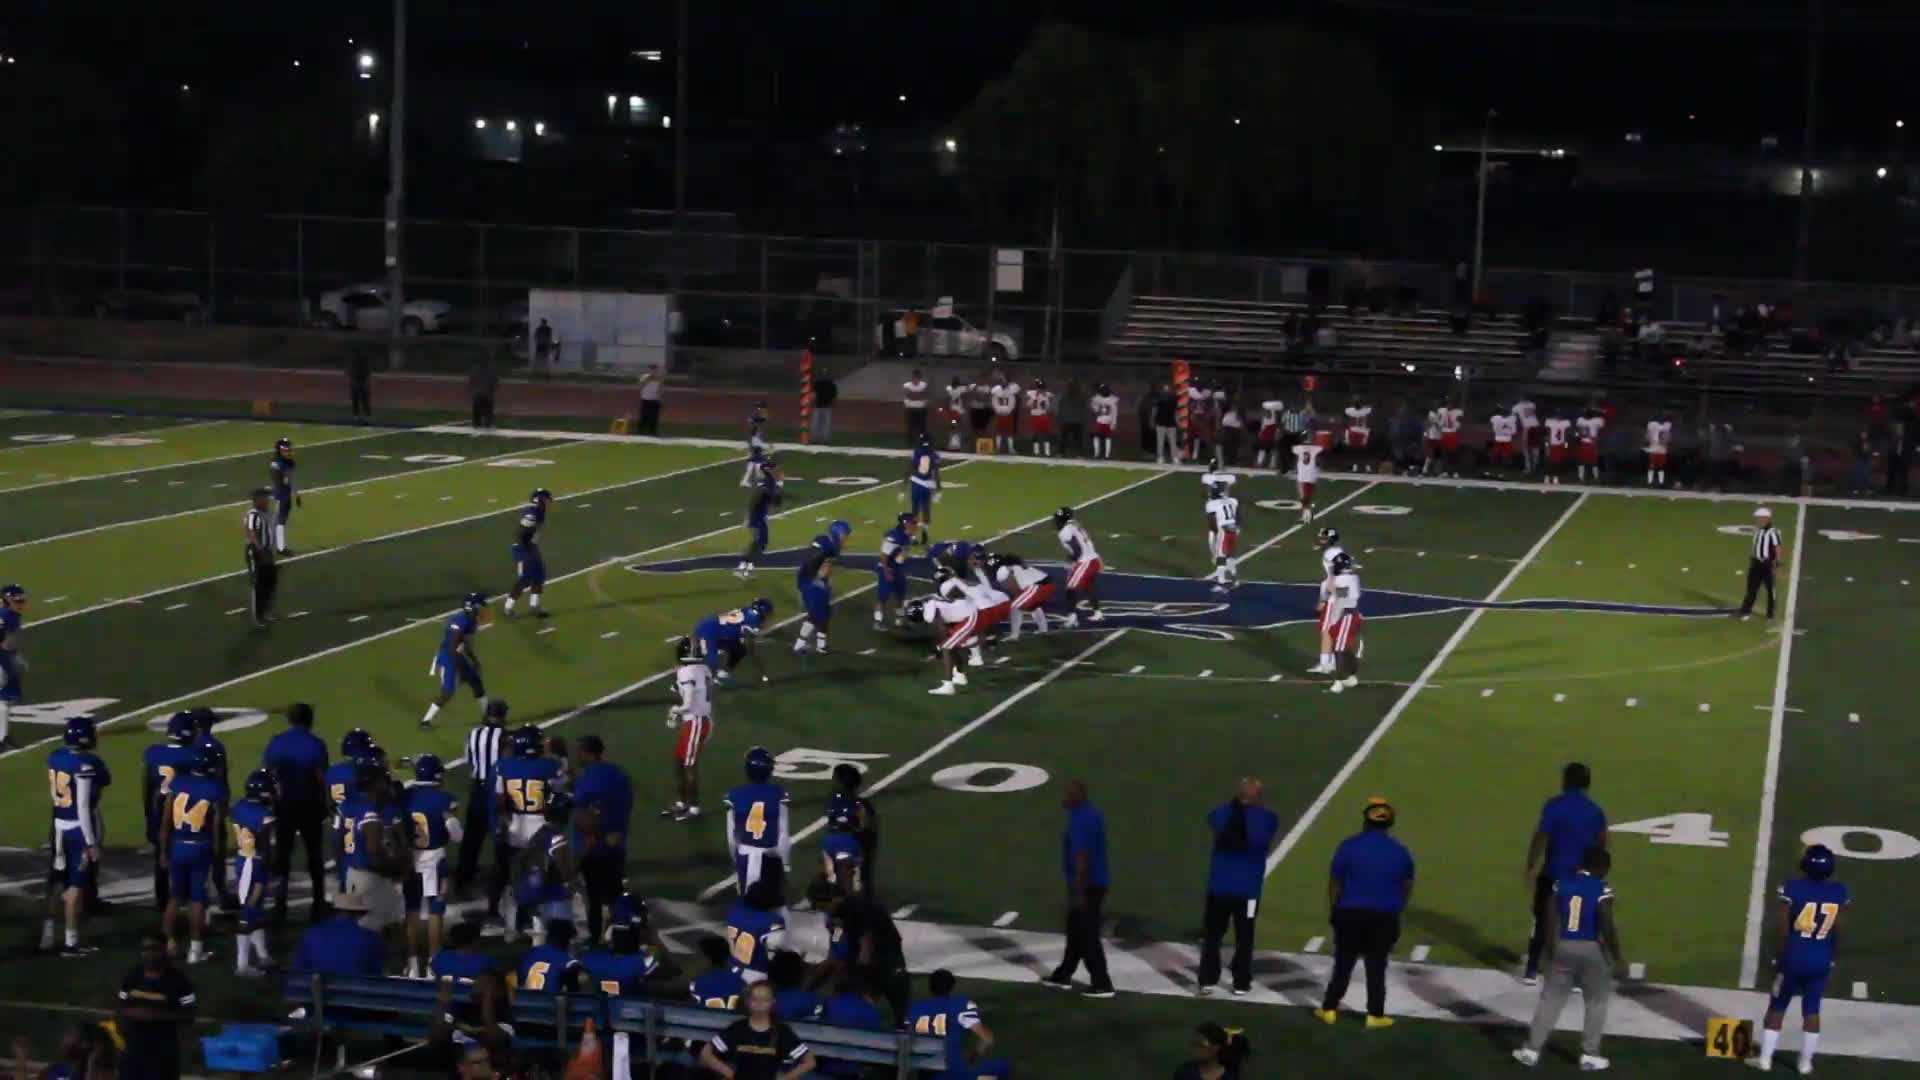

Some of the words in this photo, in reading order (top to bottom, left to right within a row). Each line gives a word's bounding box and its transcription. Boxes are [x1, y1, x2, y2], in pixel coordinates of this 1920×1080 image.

[506, 779, 545, 812] 55
[745, 801, 766, 840] 4
[1568, 895, 1583, 933] 1
[1794, 902, 1840, 940] 47
[1712, 1023, 1752, 1059] 40
